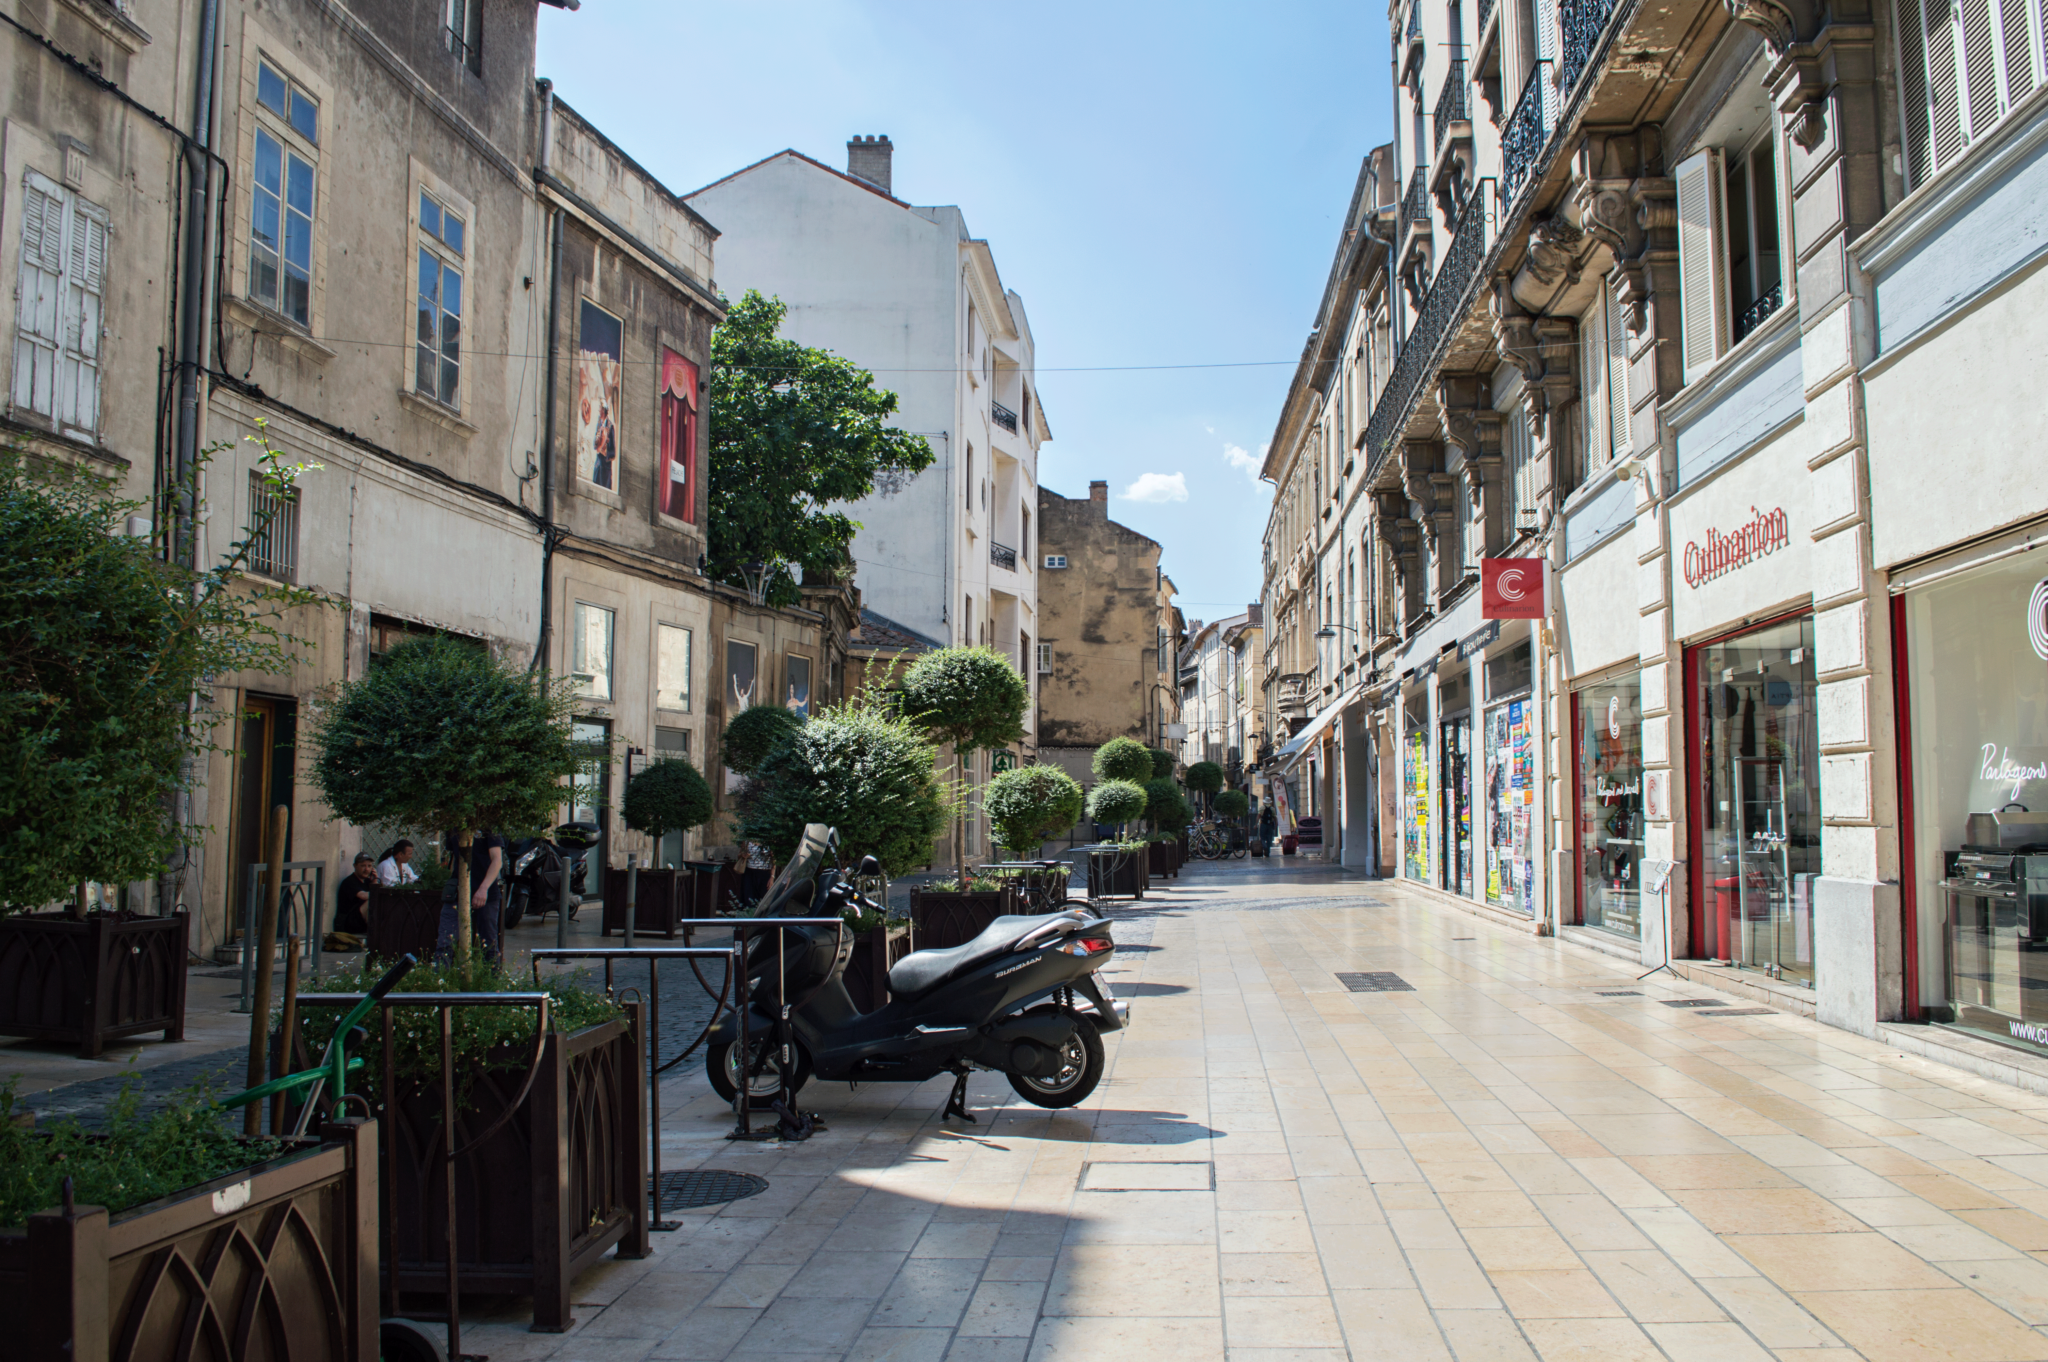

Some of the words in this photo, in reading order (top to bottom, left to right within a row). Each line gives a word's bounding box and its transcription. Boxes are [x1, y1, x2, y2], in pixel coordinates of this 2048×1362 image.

[1684, 505, 1786, 586] Culinarion
[1493, 604, 1535, 613] Culinarion
[1463, 630, 1491, 654] Bijouterie
[1980, 743, 2047, 801] Partageons
[995, 956, 1042, 979] BURGMAN
